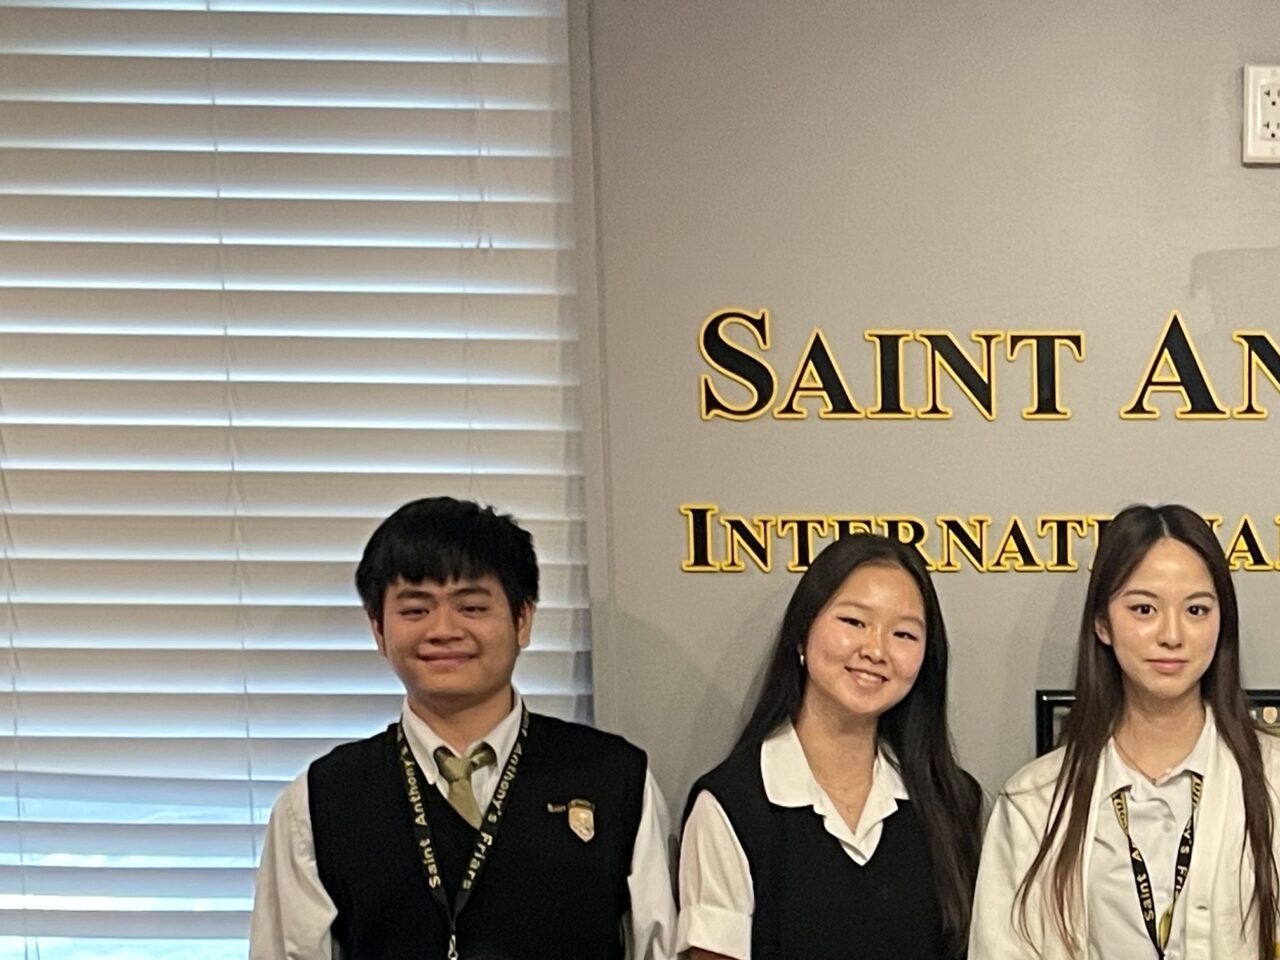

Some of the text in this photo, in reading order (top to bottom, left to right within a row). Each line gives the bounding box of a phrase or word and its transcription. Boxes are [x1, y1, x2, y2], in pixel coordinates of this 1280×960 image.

[699, 307, 1085, 421] SAINT
[419, 837, 442, 889] Saint
[462, 831, 493, 890] Friars
[1137, 873, 1155, 922] Saint
